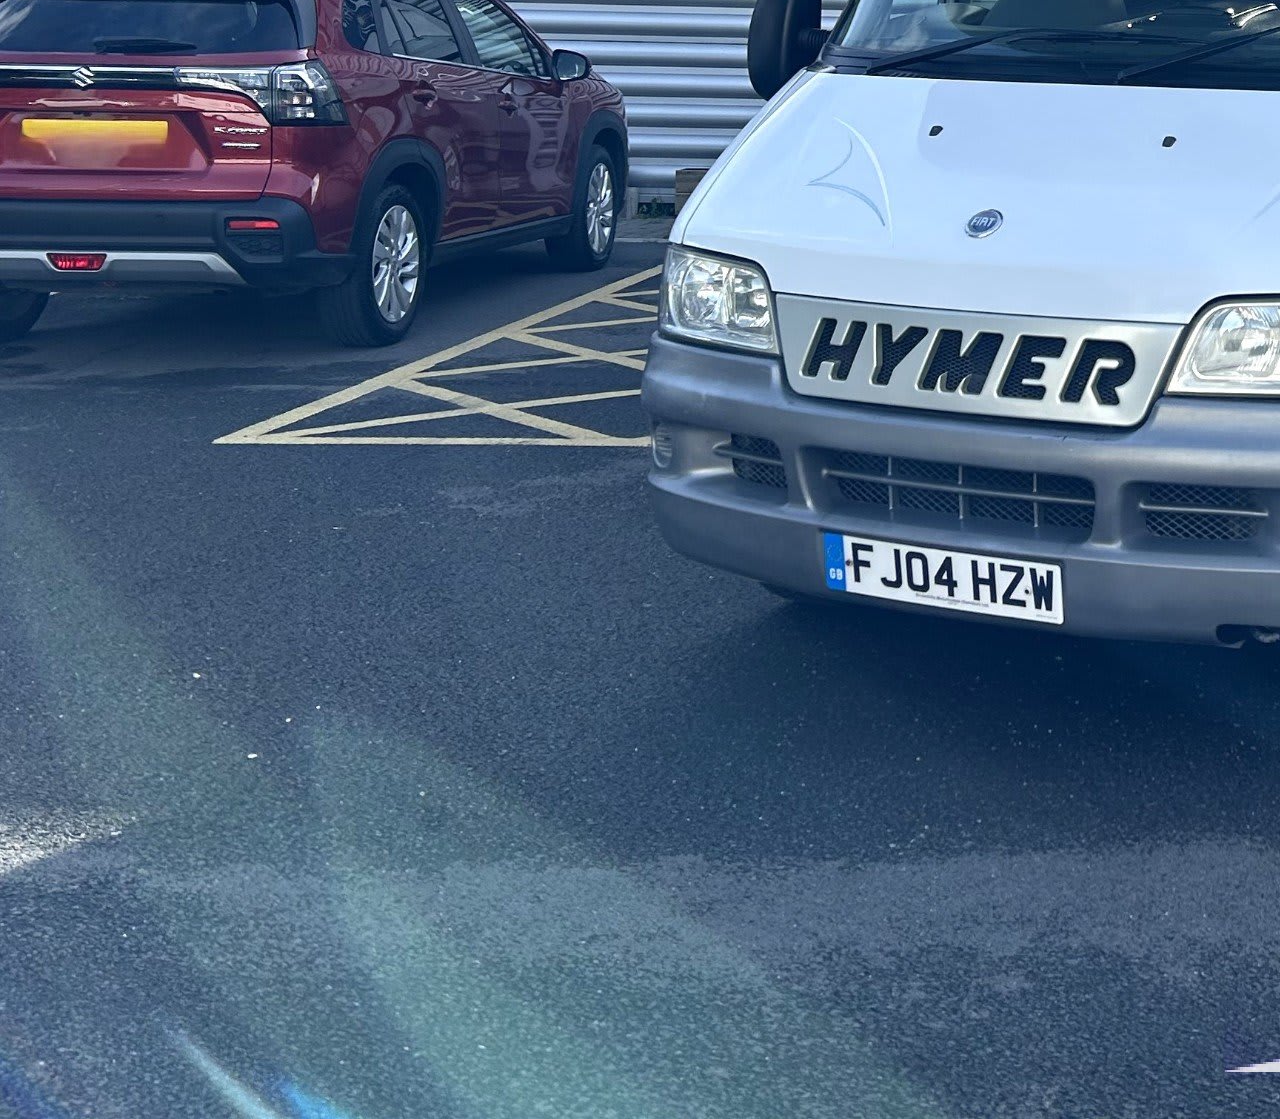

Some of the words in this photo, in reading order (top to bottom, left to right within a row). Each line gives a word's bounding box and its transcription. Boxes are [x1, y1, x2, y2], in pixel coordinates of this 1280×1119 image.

[970, 216, 996, 227] FIAT
[799, 317, 1136, 407] HYMER
[829, 567, 844, 581] GB
[850, 541, 958, 599] FJ04
[970, 559, 1055, 613] HZW
